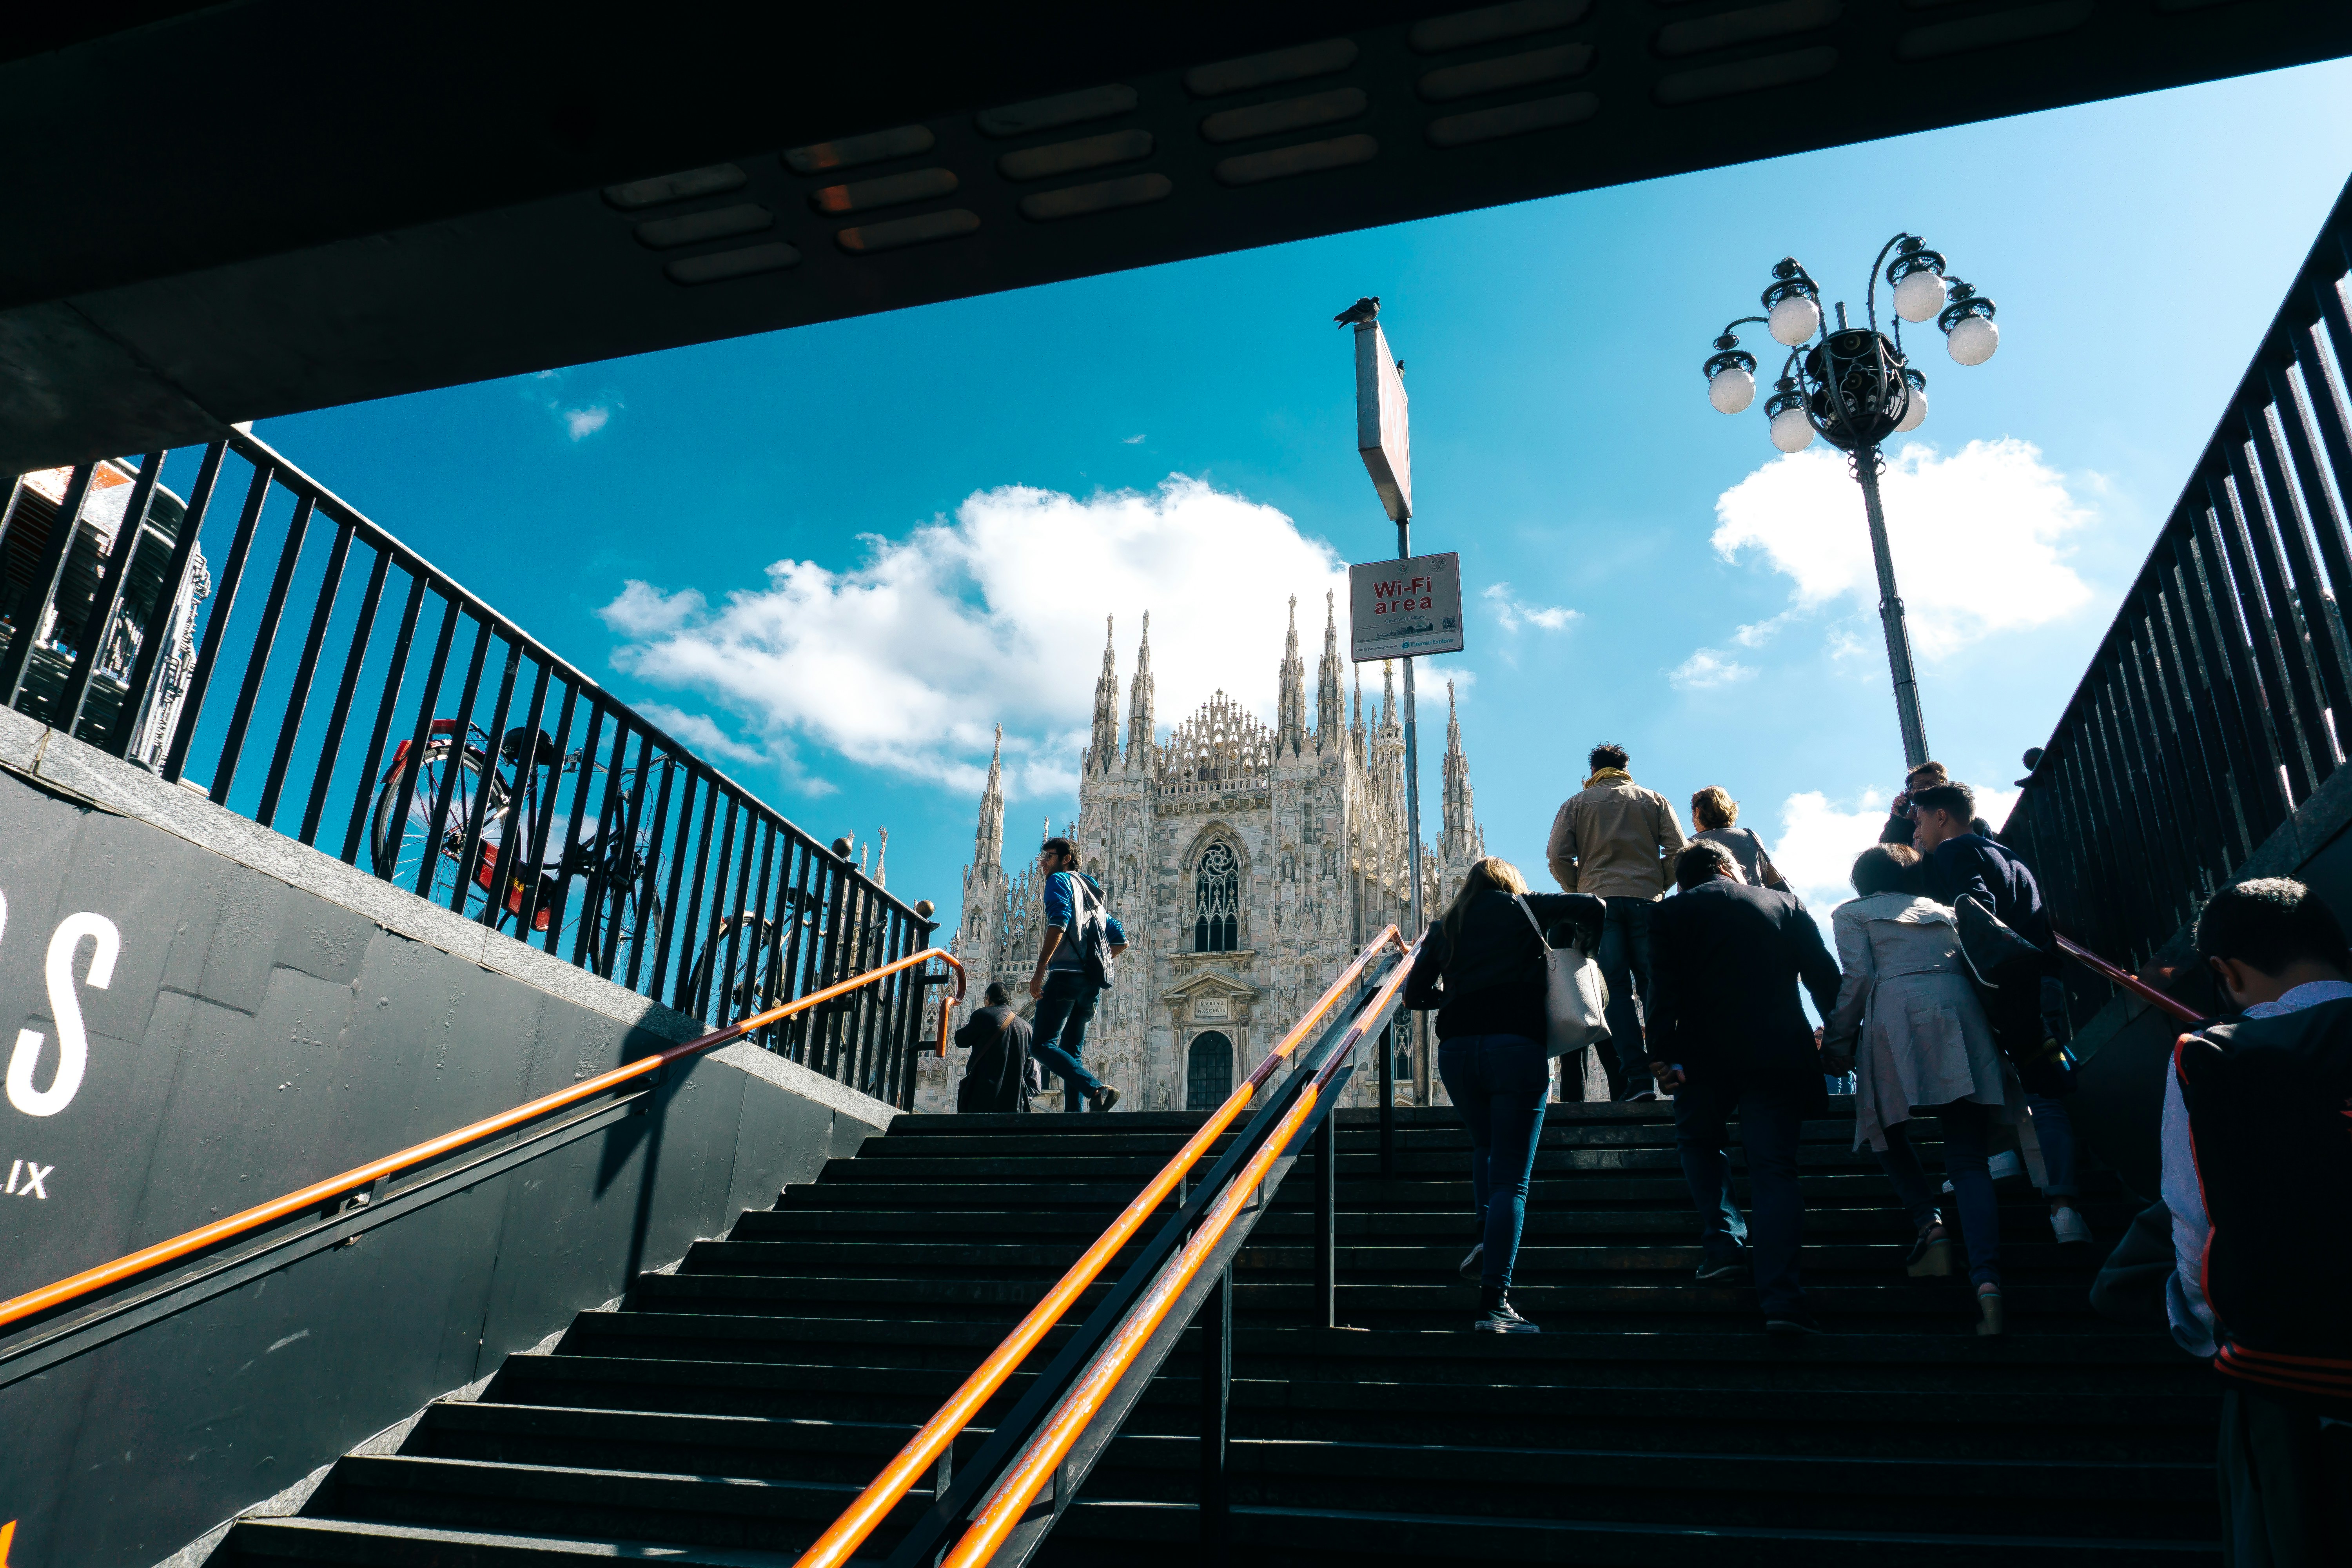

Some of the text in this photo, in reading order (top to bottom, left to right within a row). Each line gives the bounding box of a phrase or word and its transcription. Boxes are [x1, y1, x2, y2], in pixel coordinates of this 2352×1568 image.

[1384, 377, 1408, 483] M
[1373, 576, 1432, 599] Wi-Fi
[1375, 596, 1432, 615] area
[0, 888, 120, 1116] S
[0, 1159, 56, 1200] IX
